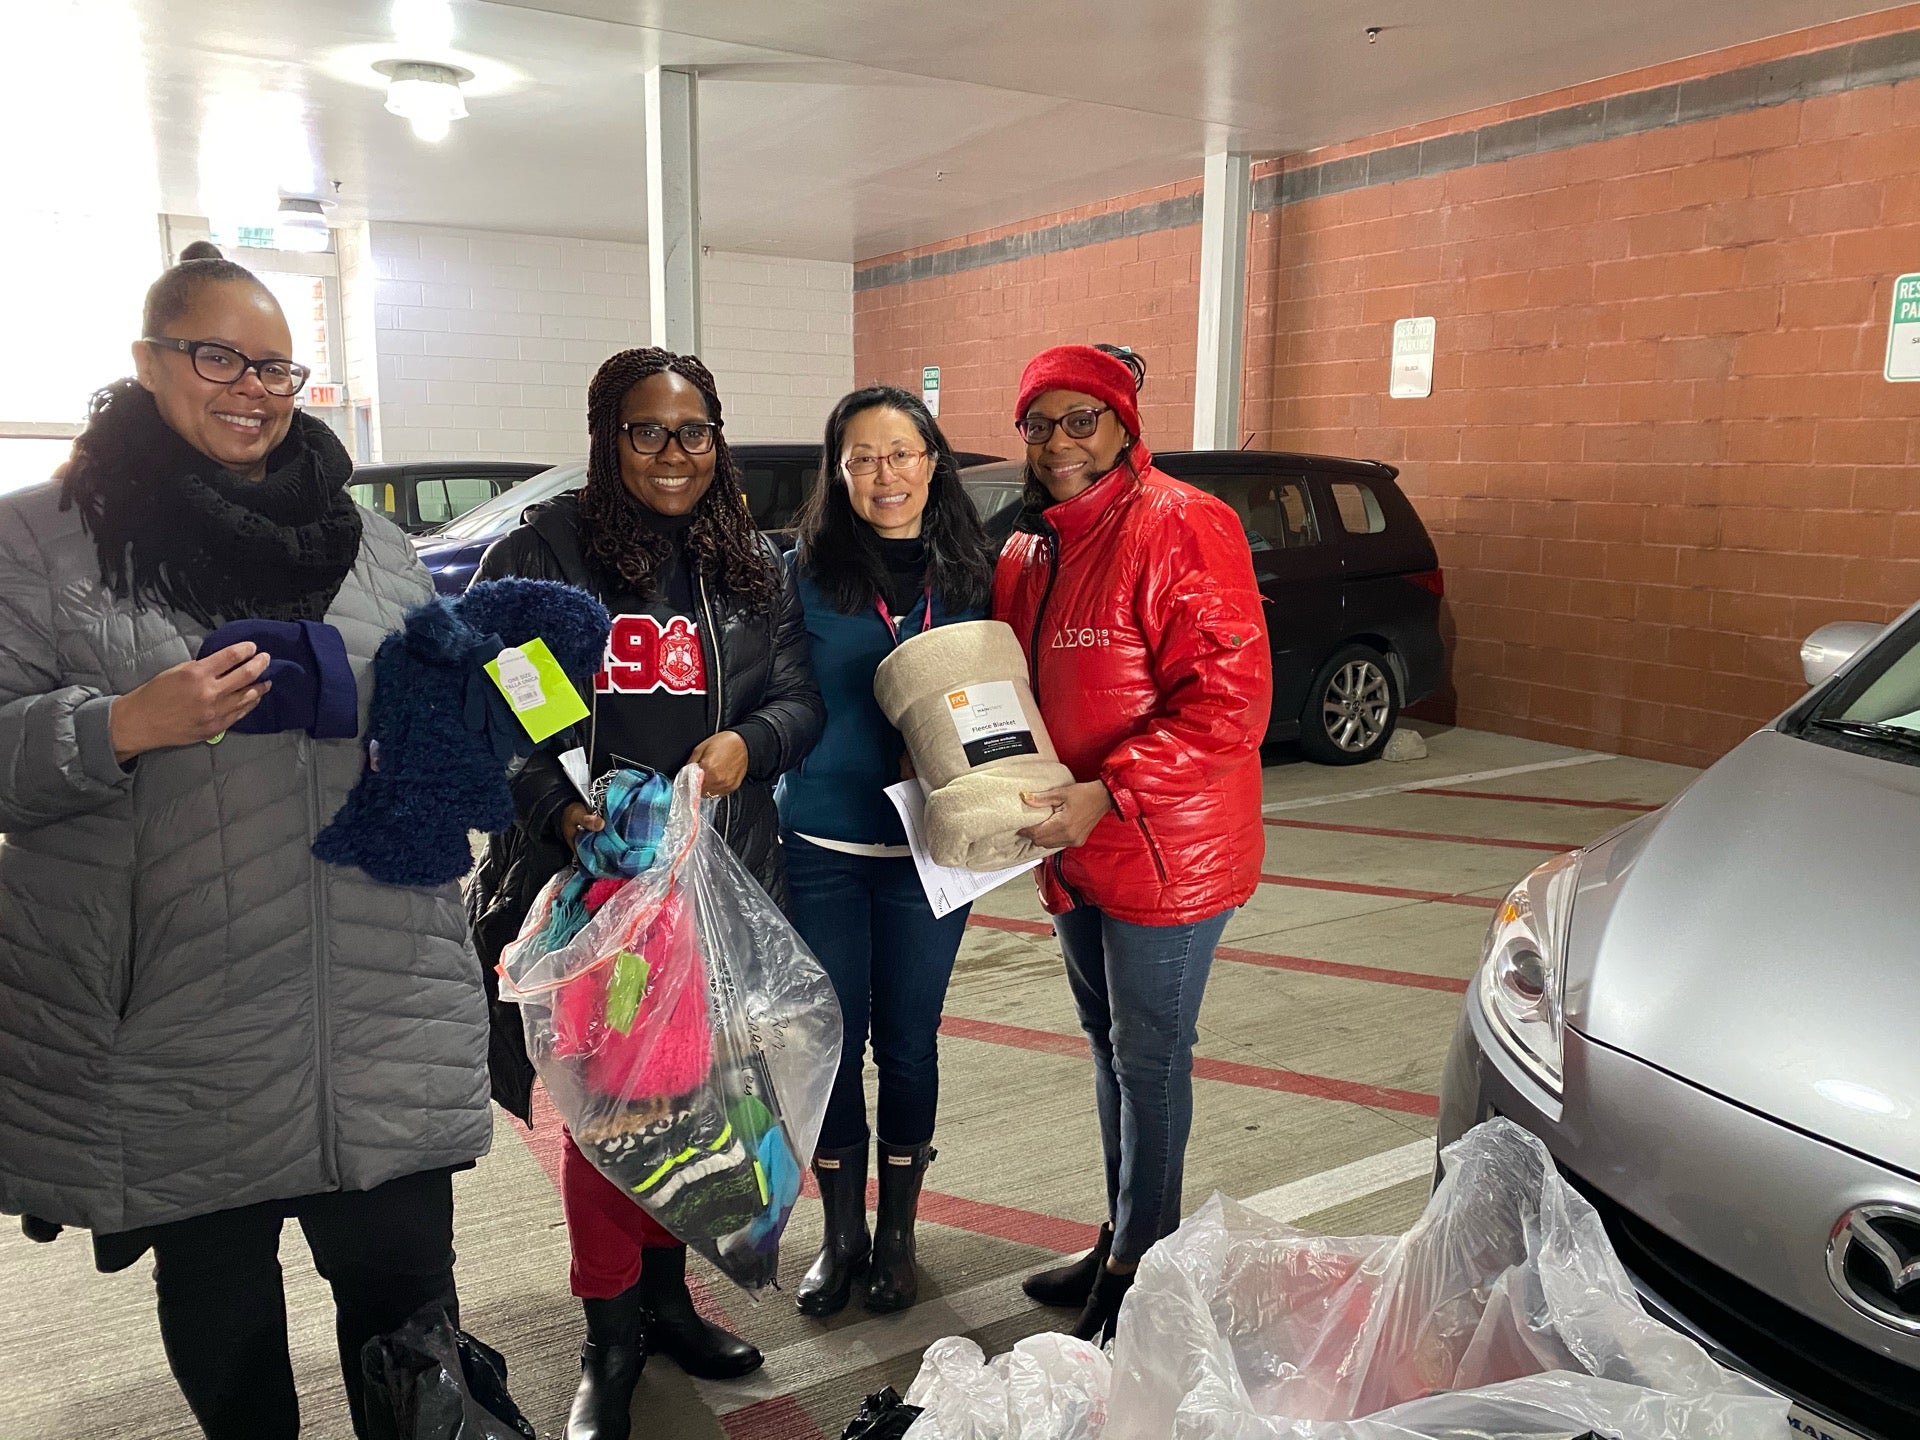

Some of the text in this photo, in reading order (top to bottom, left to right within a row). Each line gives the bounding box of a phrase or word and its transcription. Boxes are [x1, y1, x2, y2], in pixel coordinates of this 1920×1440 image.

[311, 386, 335, 403] EXIT
[972, 723, 992, 733] Fleece
[992, 719, 1016, 728] Blanket
